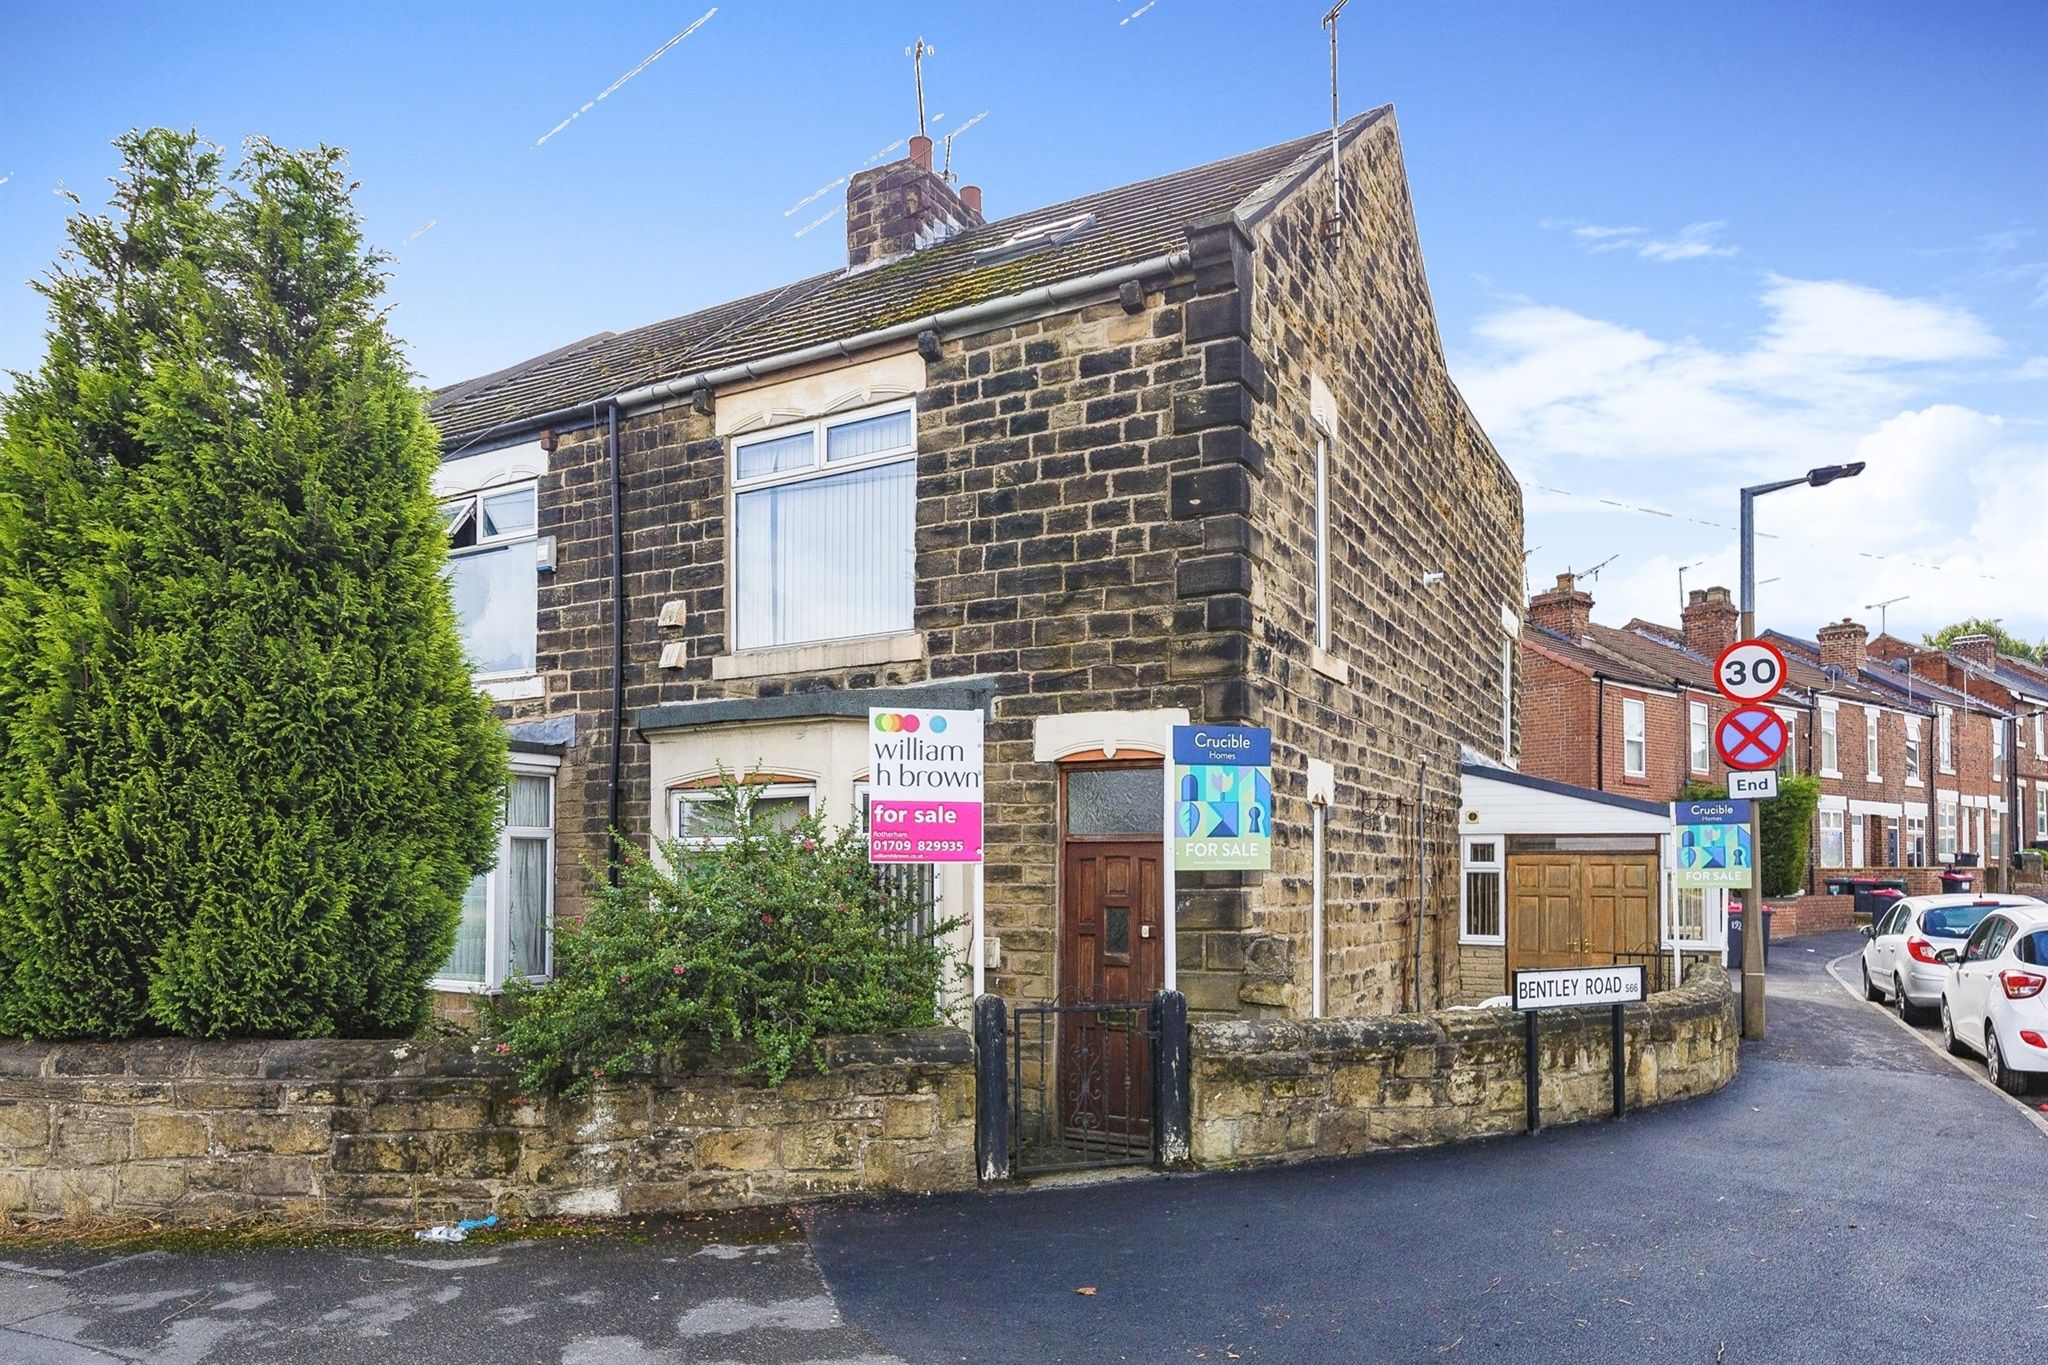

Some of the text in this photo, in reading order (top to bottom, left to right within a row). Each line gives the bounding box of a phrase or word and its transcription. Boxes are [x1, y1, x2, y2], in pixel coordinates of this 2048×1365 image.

[1725, 658, 1776, 686] 30
[1195, 733, 1251, 749] Crucible
[874, 737, 964, 762] william
[1209, 751, 1236, 760] Homes
[877, 763, 979, 788] h brown
[1736, 778, 1769, 792] End
[873, 804, 957, 824] for sale
[1691, 804, 1734, 815] Crucible
[873, 840, 964, 852] 01709 829935
[1185, 843, 1259, 857] FOR SALE
[1685, 871, 1742, 881] FOR SALE
[1519, 976, 1638, 1000] BENTLEY ROAD S66
